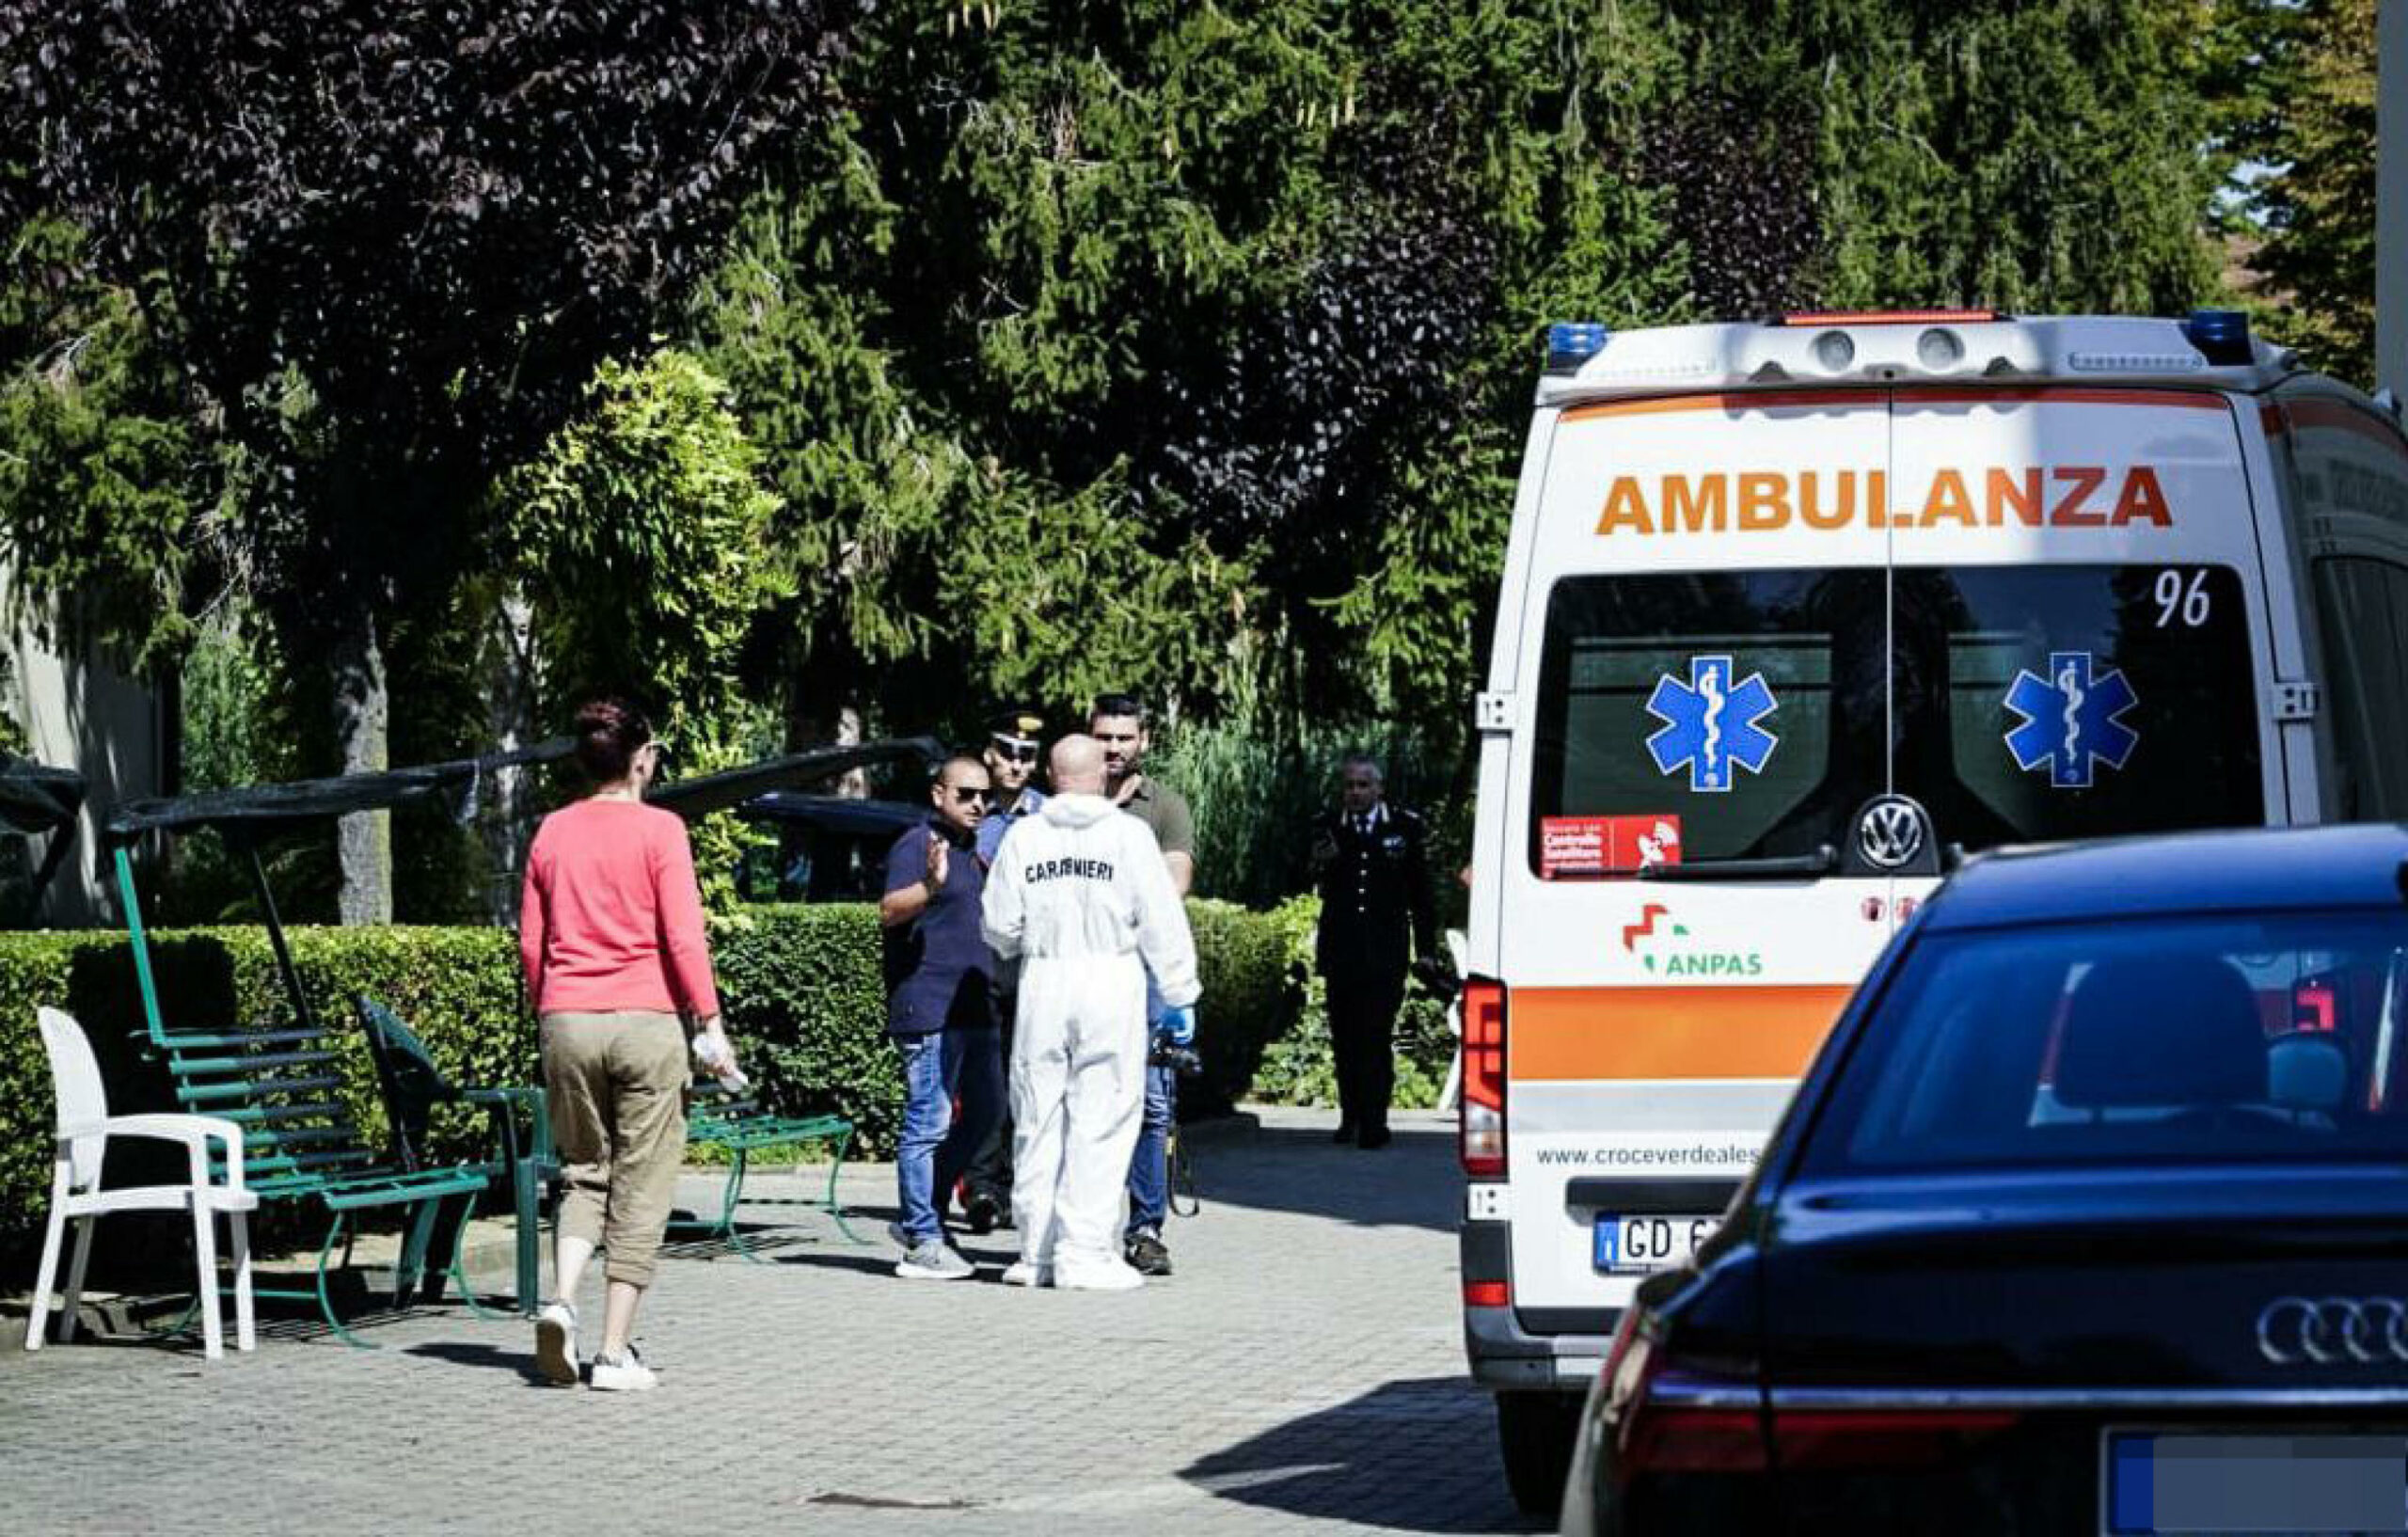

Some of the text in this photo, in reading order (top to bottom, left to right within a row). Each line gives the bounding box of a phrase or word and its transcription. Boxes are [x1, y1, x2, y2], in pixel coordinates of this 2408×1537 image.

[1595, 467, 2173, 535] AMBULANZA
[2155, 569, 2210, 628] 96
[1025, 856, 1114, 884] CARBNIERI
[1666, 954, 1763, 975] ANPAS
[1537, 1144, 1761, 1165] www.croceverdeales
[1627, 1219, 1671, 1258] GD
